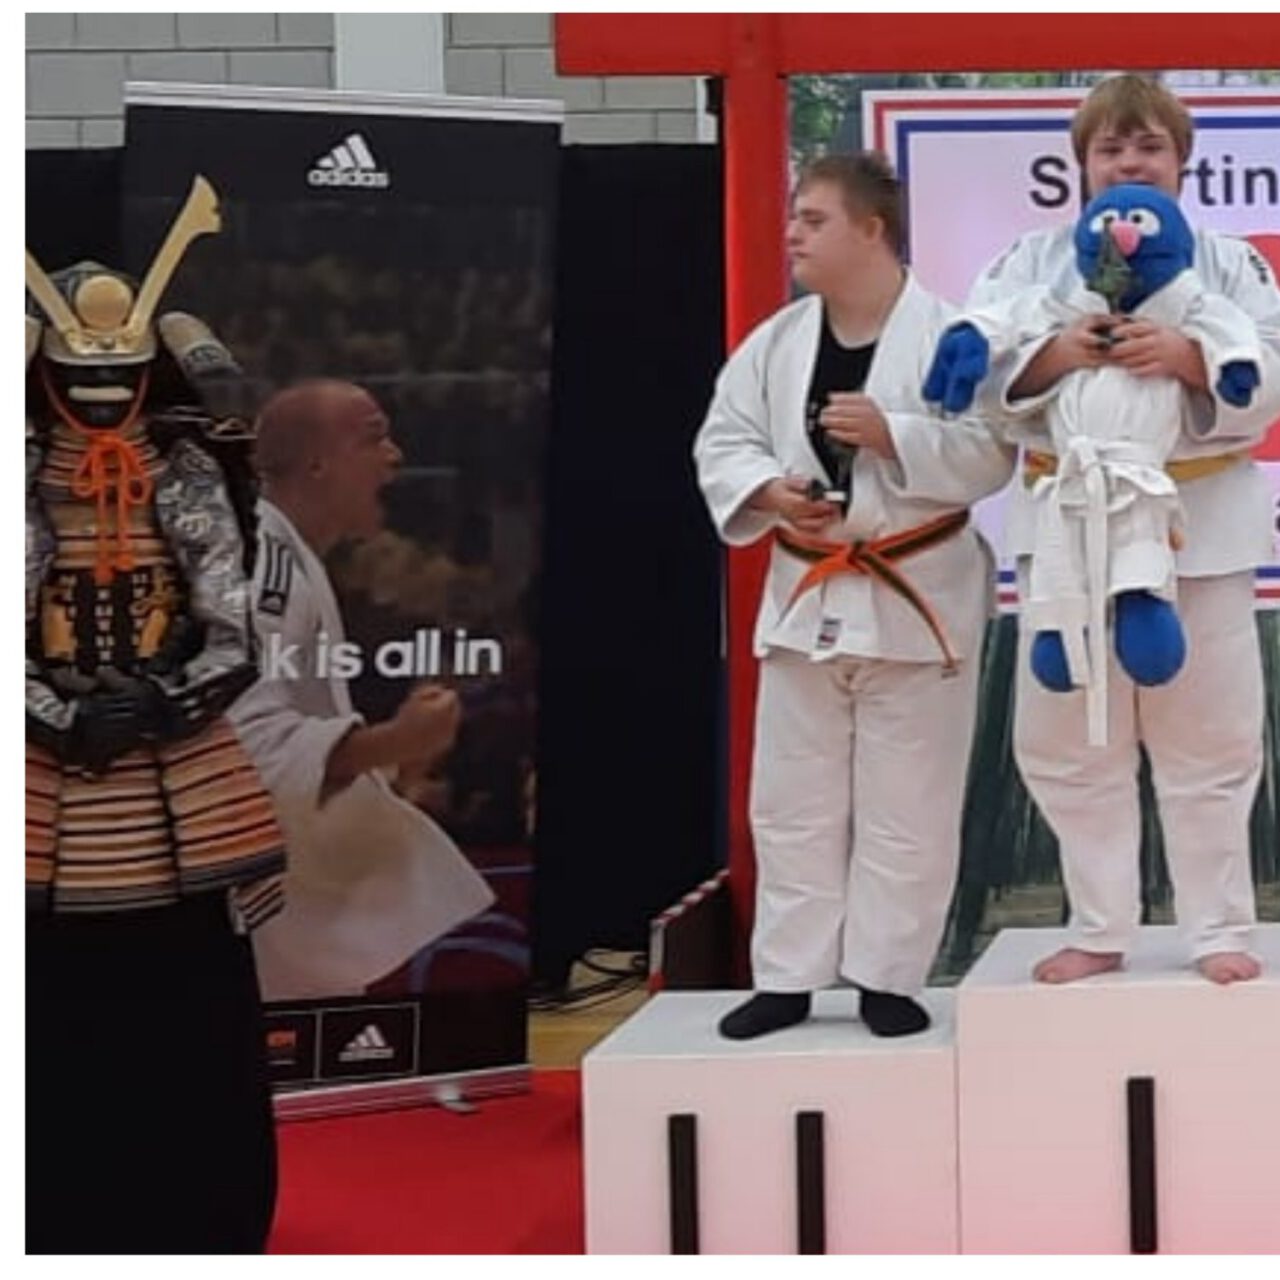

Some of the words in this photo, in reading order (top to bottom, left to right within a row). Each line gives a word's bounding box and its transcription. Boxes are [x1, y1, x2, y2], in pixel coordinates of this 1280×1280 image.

[315, 631, 363, 680] is
[374, 629, 441, 679] all
[453, 628, 502, 675] in
